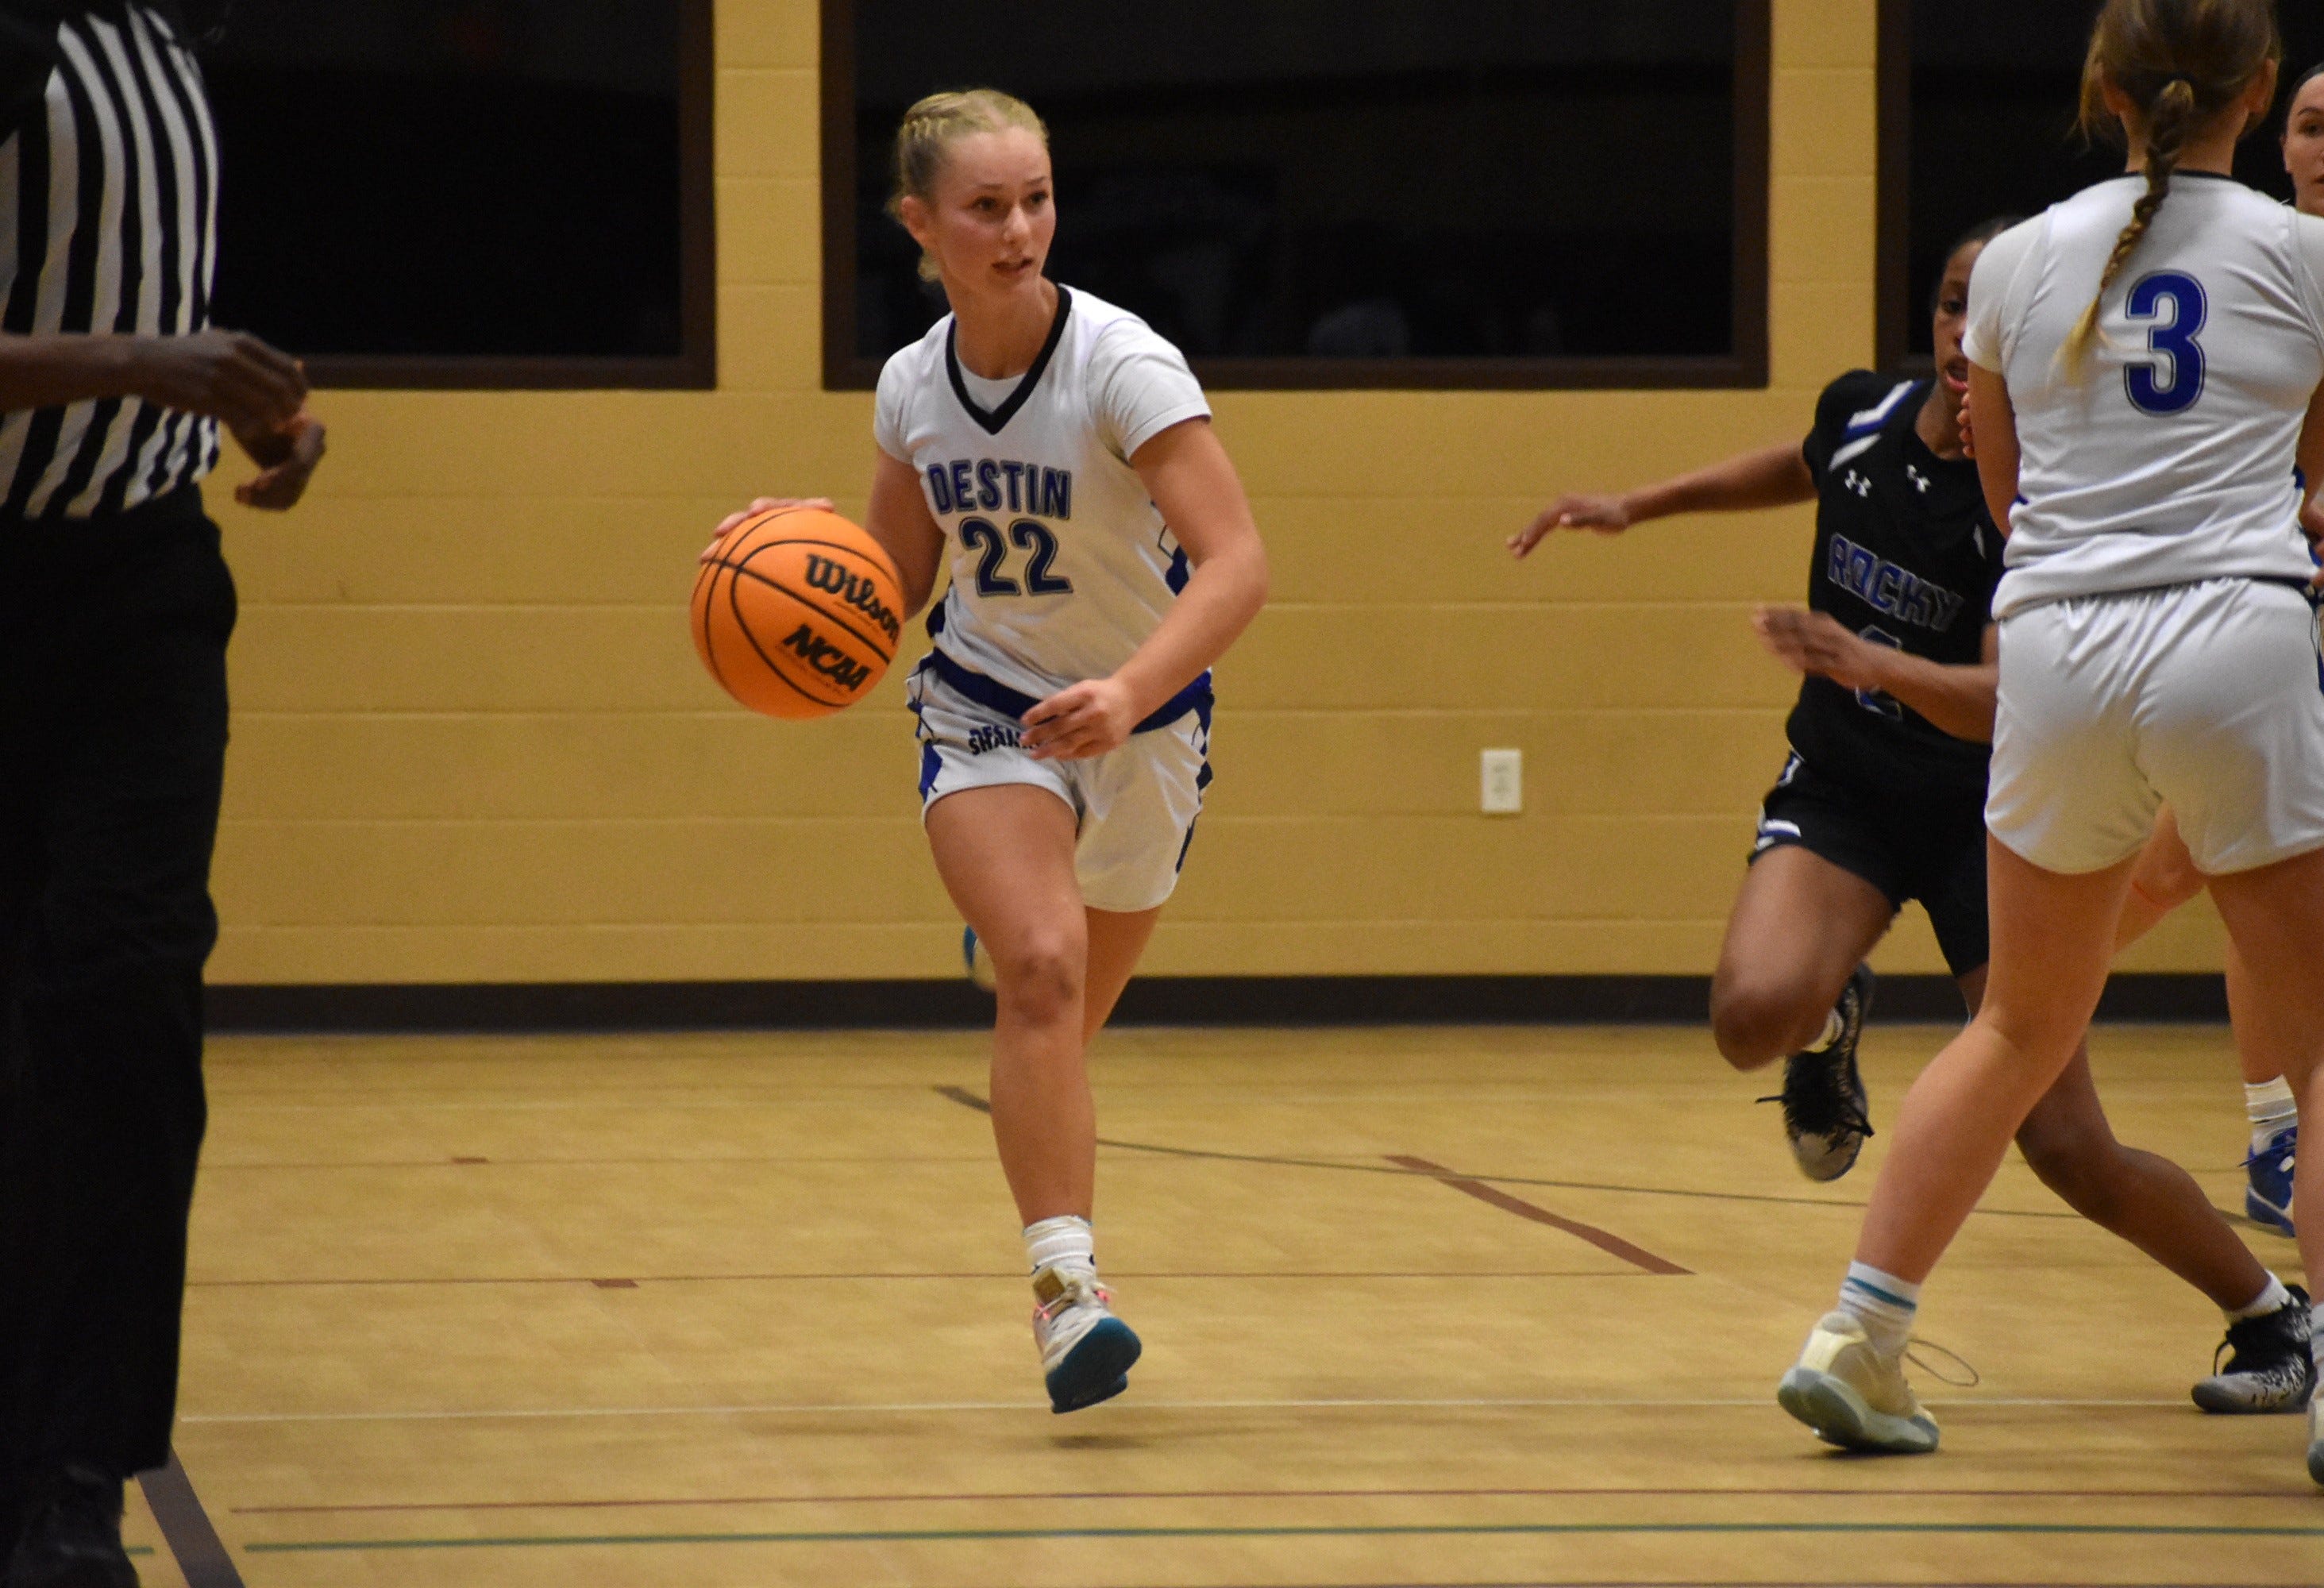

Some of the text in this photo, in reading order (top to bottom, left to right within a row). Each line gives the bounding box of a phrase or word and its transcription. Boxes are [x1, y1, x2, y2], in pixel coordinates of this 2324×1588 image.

[2123, 268, 2208, 418] 3
[926, 457, 1072, 520] DESTIN
[958, 516, 1073, 597] 22
[1828, 533, 1964, 633] ROCKY
[783, 623, 872, 692] NCAA
